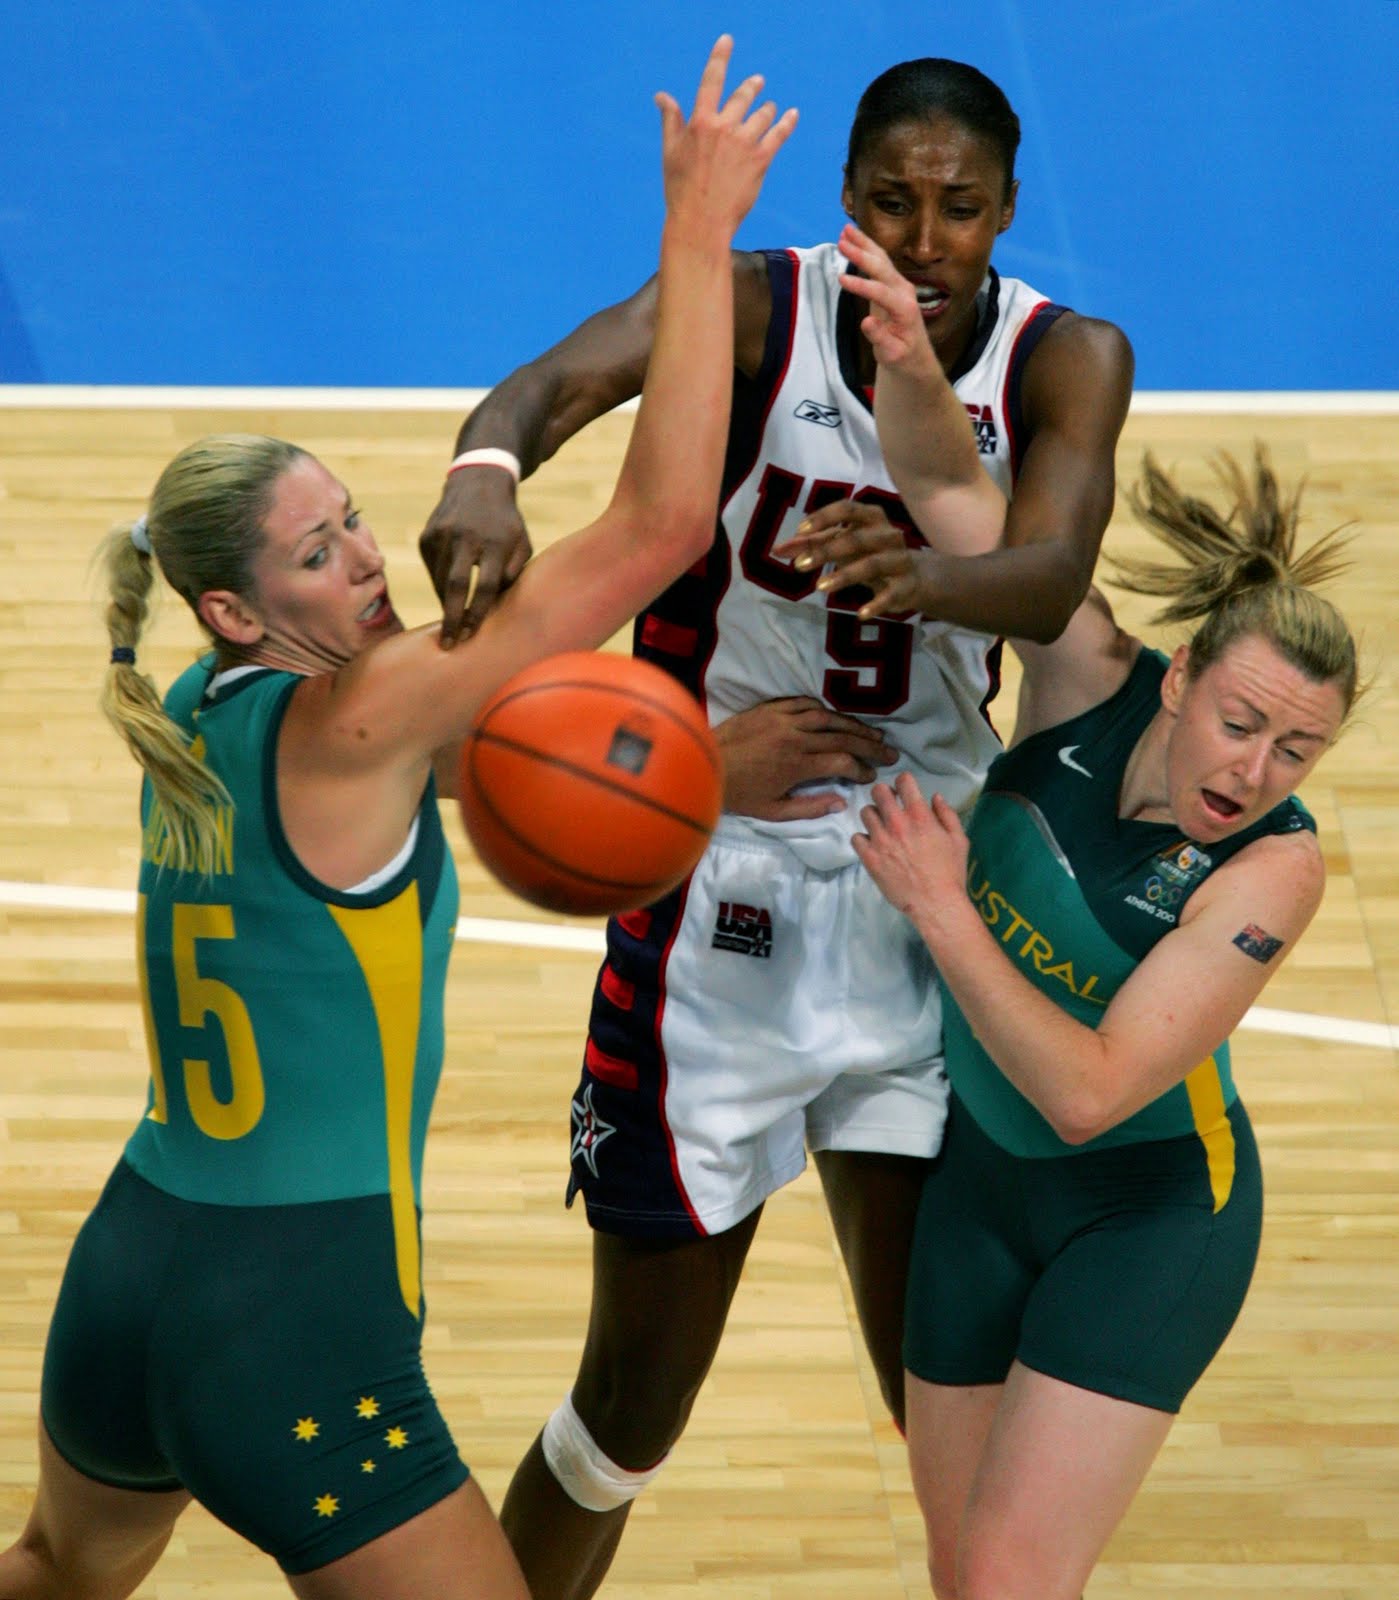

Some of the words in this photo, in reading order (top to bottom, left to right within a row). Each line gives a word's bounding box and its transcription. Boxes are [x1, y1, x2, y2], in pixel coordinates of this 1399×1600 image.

[822, 609, 914, 716] 9
[716, 901, 773, 941] USA
[1123, 894, 1157, 915] ATHENS
[1154, 908, 1176, 923] 200
